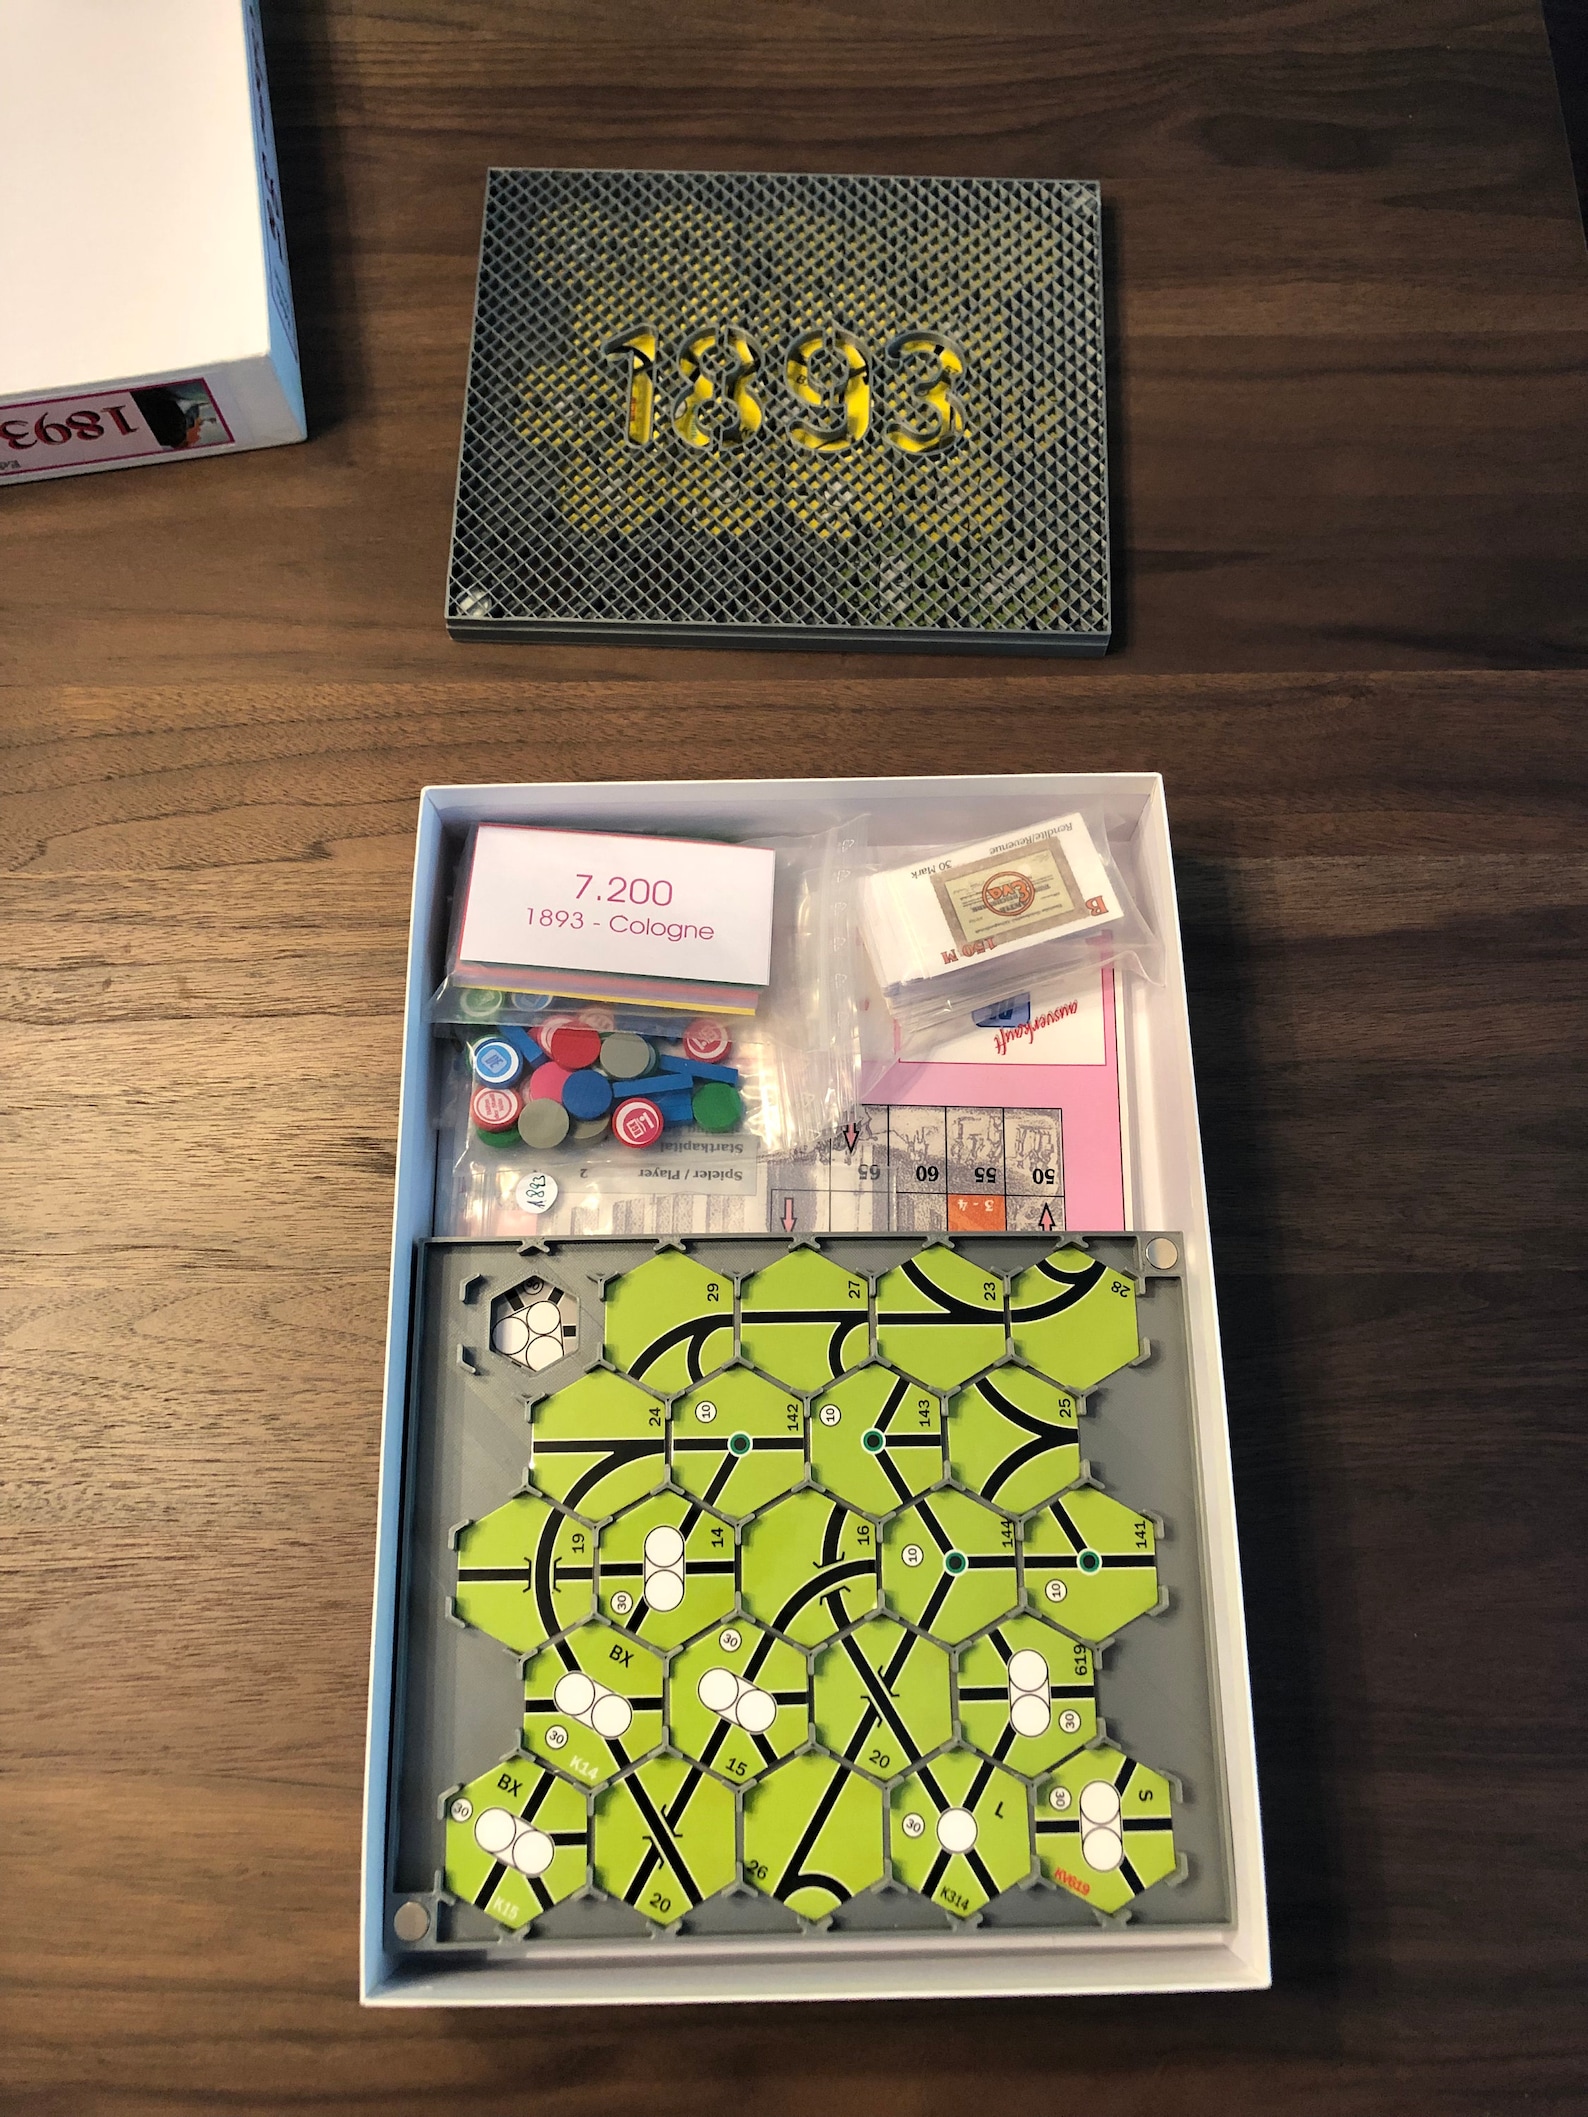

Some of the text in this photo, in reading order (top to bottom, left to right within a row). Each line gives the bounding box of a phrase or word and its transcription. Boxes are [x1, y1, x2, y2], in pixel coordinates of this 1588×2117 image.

[601, 323, 967, 454] 1893
[0, 405, 139, 450] 1893
[989, 822, 1073, 855] Rendite/Revenue
[911, 860, 952, 880] 30 Mark
[575, 873, 673, 907] 7.200
[987, 879, 1030, 903] Eva
[1085, 895, 1109, 916] B
[527, 907, 584, 930] 1893
[608, 914, 715, 942] Cologne
[940, 936, 998, 965] 150 M
[994, 999, 1078, 1056] ausverkauft
[660, 1140, 744, 1154] Startkapital
[580, 1168, 589, 1178] 2
[637, 1167, 680, 1180] Player
[693, 1168, 743, 1181] Spieler
[858, 1164, 881, 1180] 65
[915, 1165, 939, 1181] 60
[974, 1167, 997, 1183] 55
[1032, 1168, 1056, 1185] 50
[957, 1199, 968, 1212] 4
[984, 1199, 994, 1212] 3
[707, 1283, 719, 1302] 29
[848, 1280, 860, 1299] 27
[983, 1282, 996, 1301] 23
[1111, 1281, 1131, 1298] 28
[649, 1407, 661, 1427] 24
[701, 1404, 711, 1419] 10
[787, 1403, 799, 1432] 142
[826, 1407, 835, 1422] 10
[919, 1399, 931, 1427] 143
[1058, 1398, 1072, 1418] 25
[572, 1533, 585, 1554] 19
[711, 1527, 724, 1548] 14
[857, 1525, 870, 1545] 16
[1001, 1520, 1013, 1548] 144
[1134, 1520, 1147, 1548] 141
[908, 1547, 918, 1562] 10
[1051, 1583, 1061, 1598] 10
[617, 1594, 627, 1610] 30
[722, 1633, 738, 1647] 30
[609, 1644, 634, 1669] BX
[1073, 1644, 1088, 1676] 619
[1064, 1713, 1075, 1729] 30
[549, 1730, 565, 1744] 30
[569, 1754, 600, 1781] K14
[724, 1757, 749, 1777] 15
[868, 1749, 891, 1769] 20
[497, 1773, 523, 1797] BX
[1055, 1790, 1065, 1807] 30
[1138, 1789, 1153, 1802] S
[453, 1802, 469, 1817] 30
[994, 1801, 1004, 1819] L
[906, 1818, 921, 1833] 30
[746, 1859, 769, 1880] 26
[493, 1896, 520, 1921] K15
[650, 1892, 671, 1913] 20
[940, 1886, 970, 1911] K314
